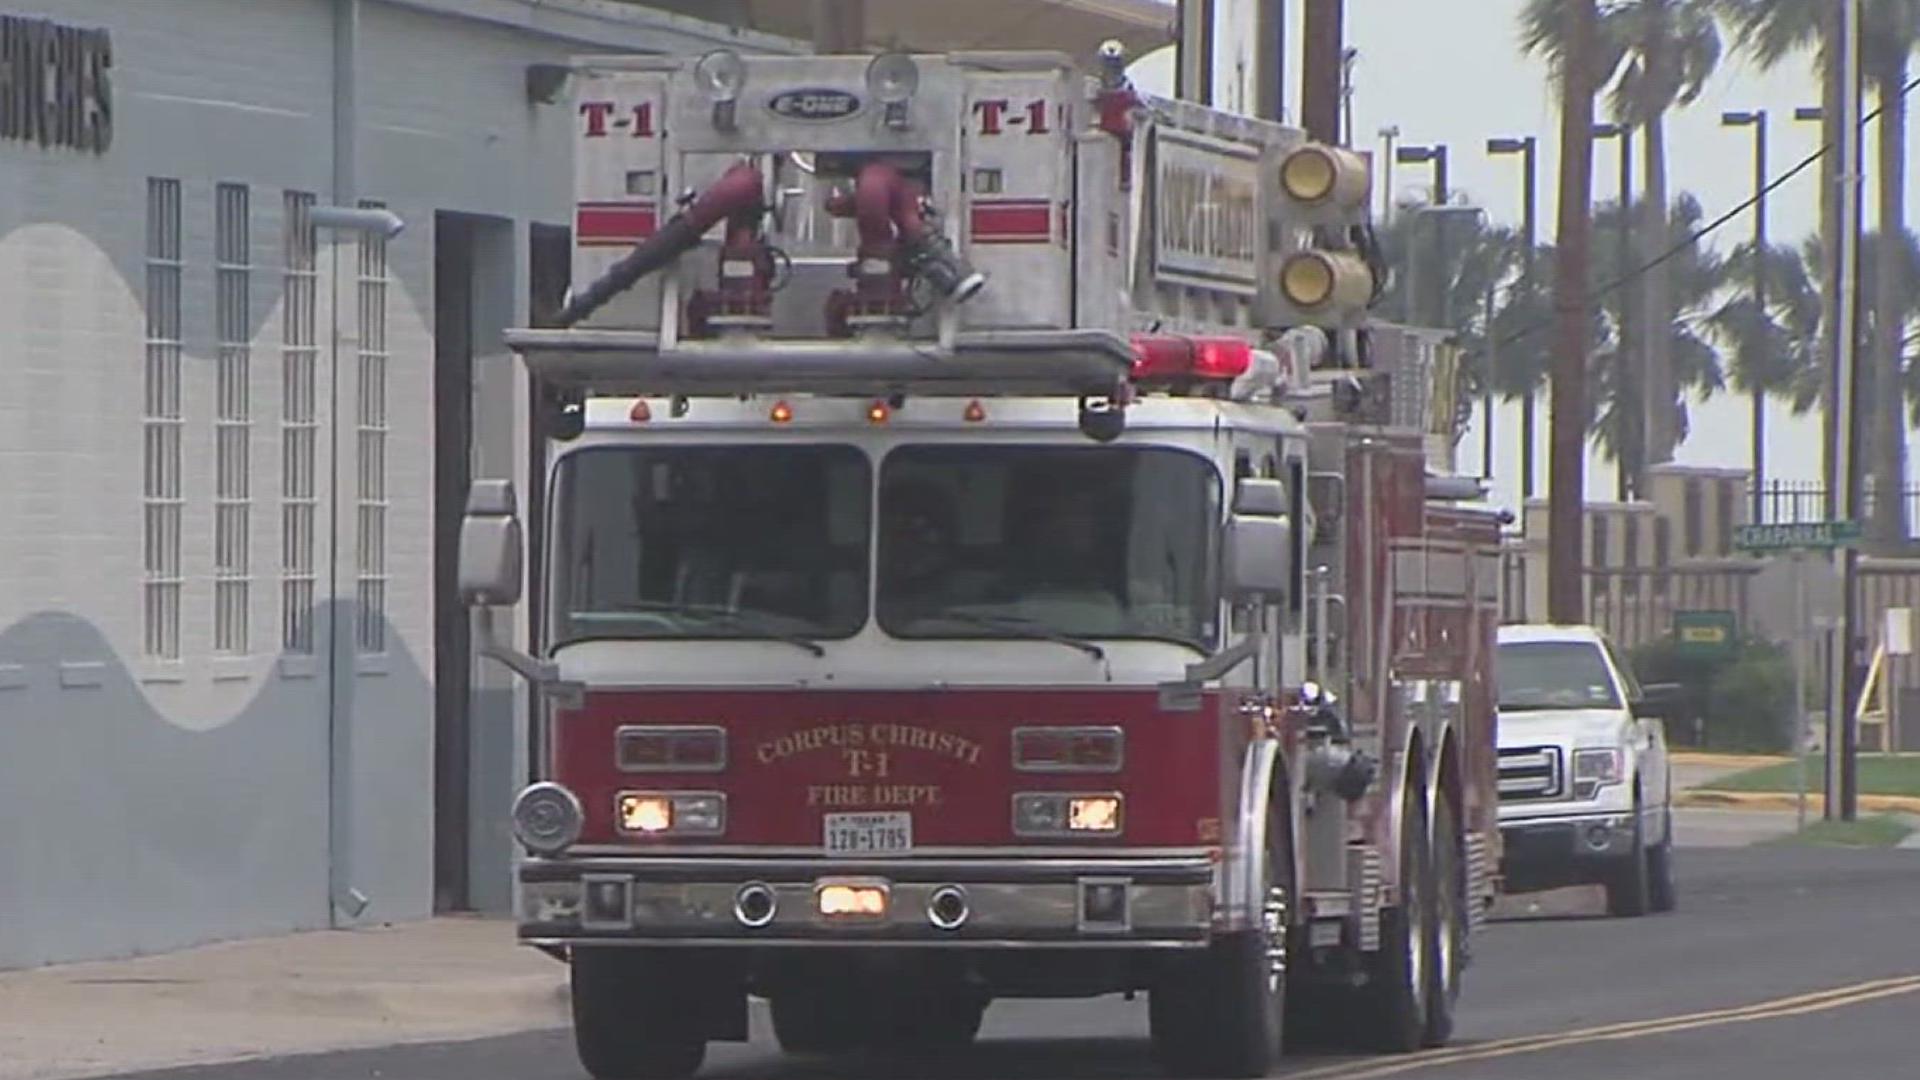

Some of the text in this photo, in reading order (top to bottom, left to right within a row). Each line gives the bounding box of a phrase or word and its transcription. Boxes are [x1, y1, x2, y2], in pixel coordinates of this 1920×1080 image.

[581, 101, 653, 138] T-1
[973, 99, 1049, 135] T-1
[757, 723, 982, 764] CORPUS CHRISTI
[843, 749, 888, 777] T-1
[807, 785, 866, 805] FIRE
